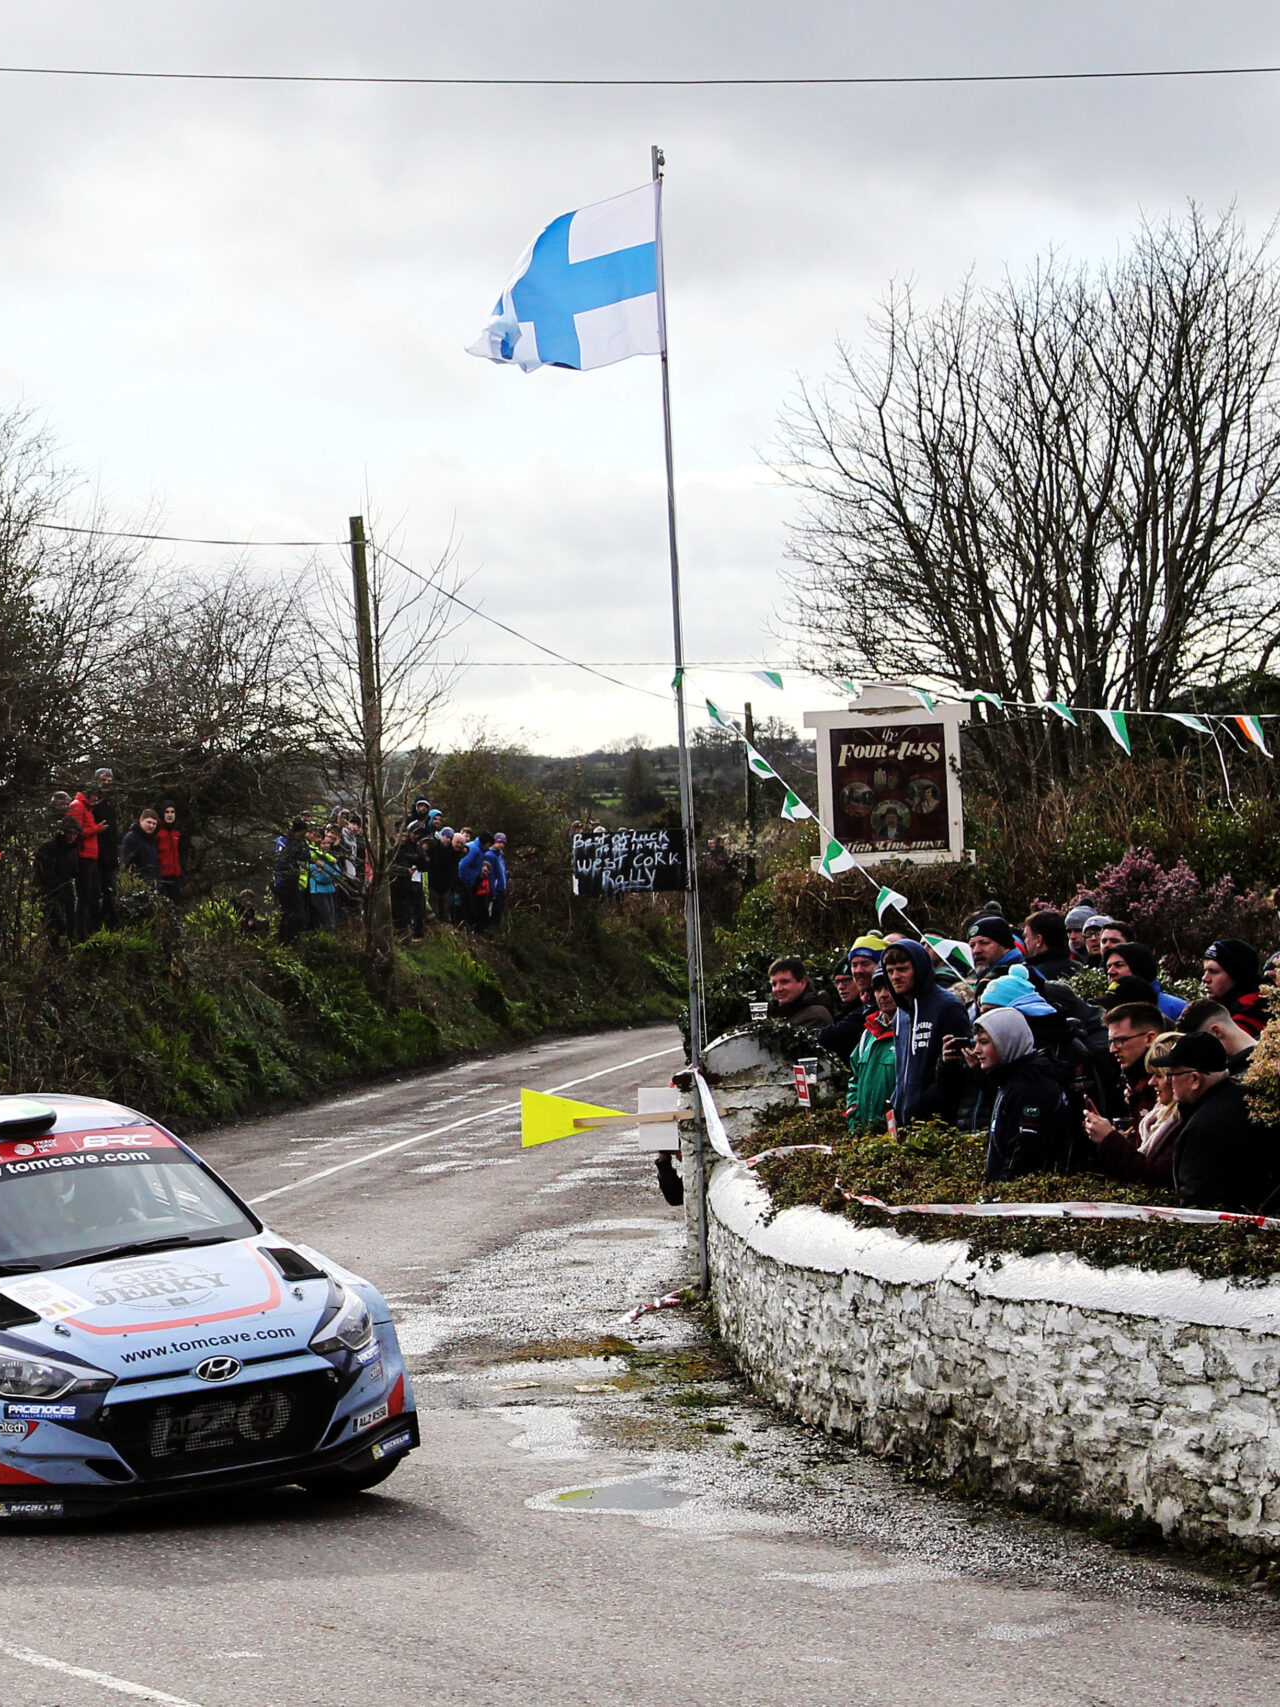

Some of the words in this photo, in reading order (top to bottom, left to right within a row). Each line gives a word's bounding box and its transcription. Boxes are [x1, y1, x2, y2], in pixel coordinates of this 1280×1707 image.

[573, 831, 610, 848] Best
[82, 1134, 153, 1149] BRC
[113, 1267, 179, 1285] GET
[94, 1273, 230, 1306] JERKY
[120, 1327, 296, 1363] www.tomcave.com
[8, 1404, 77, 1415] PACENOTES
